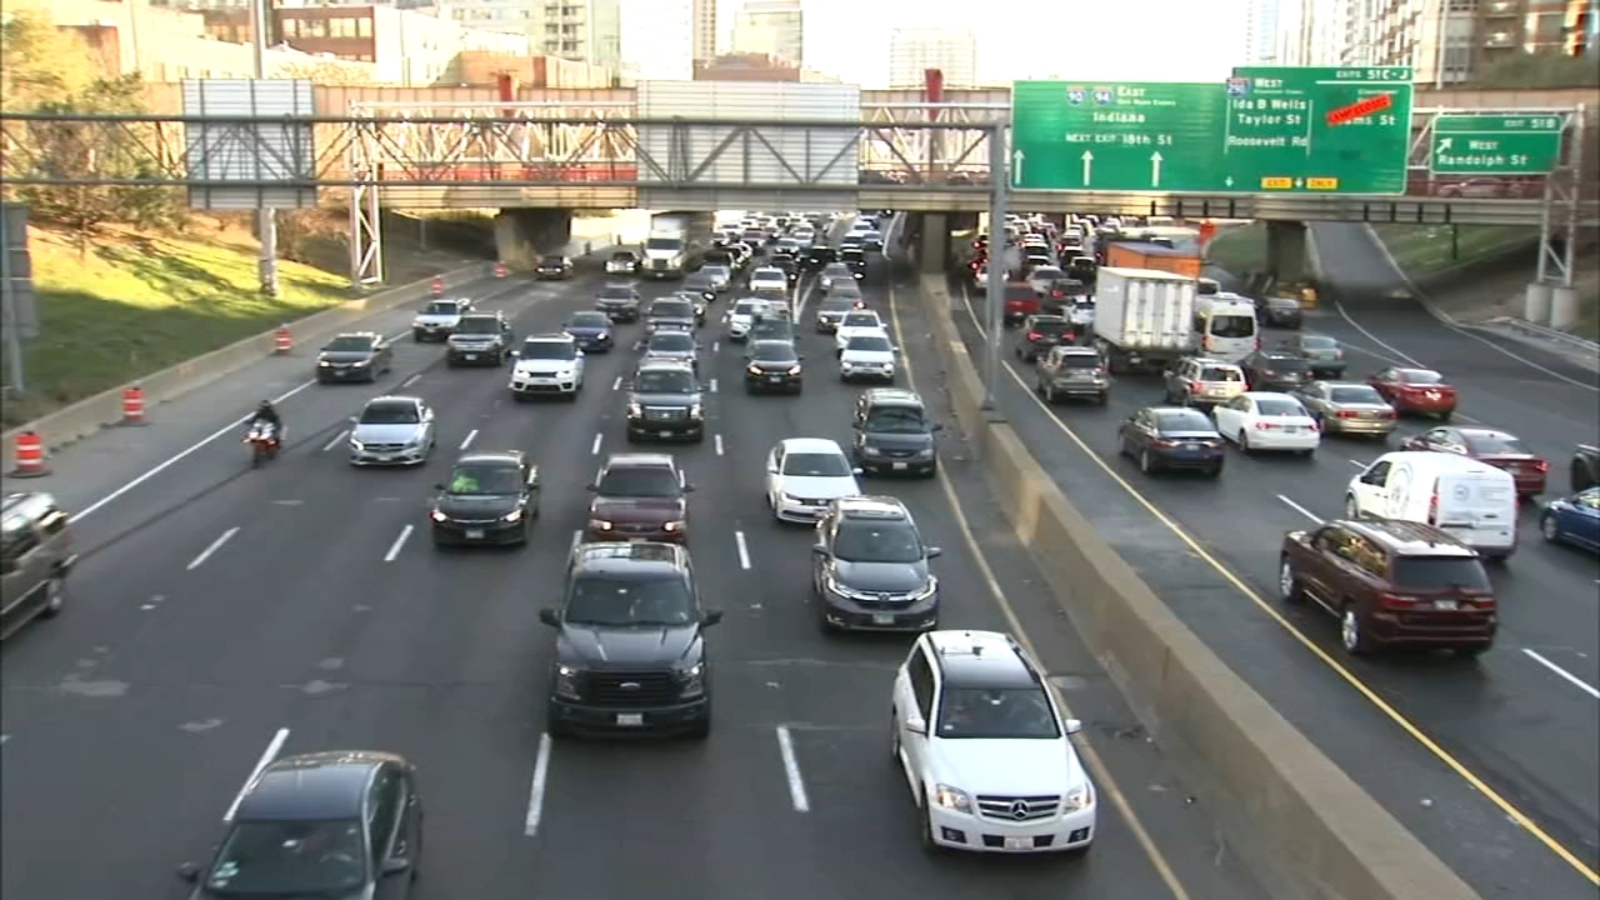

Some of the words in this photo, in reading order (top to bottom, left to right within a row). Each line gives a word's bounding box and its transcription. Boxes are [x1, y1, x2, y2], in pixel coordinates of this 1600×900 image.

[1093, 111, 1145, 123] Indiana
[1237, 113, 1281, 127] Taylor
[1286, 113, 1301, 125] St
[1380, 114, 1396, 126] St
[1122, 133, 1151, 145] 18th
[1157, 134, 1173, 145] St
[1228, 135, 1285, 147] Roosevelt
[1291, 135, 1308, 147] Rd
[1437, 154, 1505, 168] Randolph
[1509, 154, 1528, 166] St
